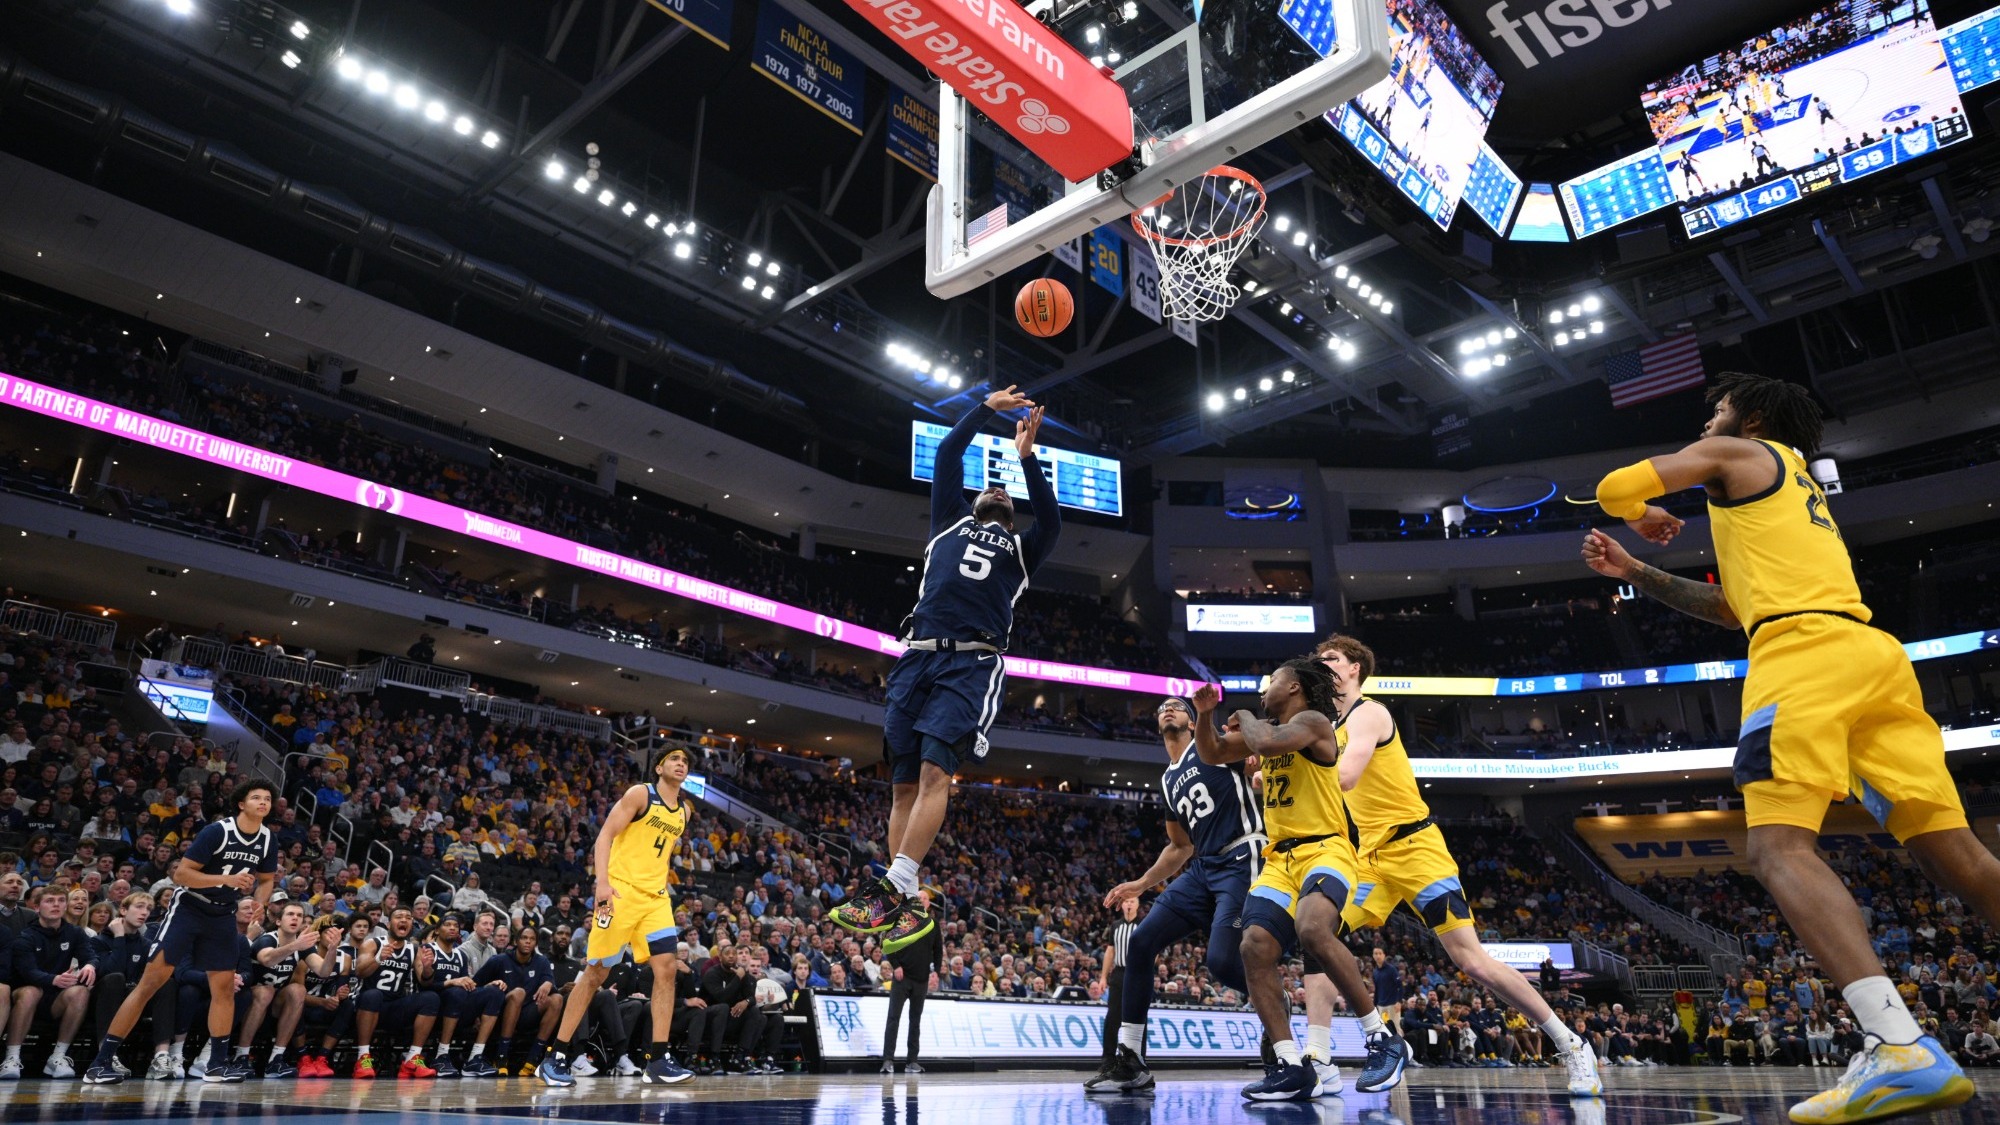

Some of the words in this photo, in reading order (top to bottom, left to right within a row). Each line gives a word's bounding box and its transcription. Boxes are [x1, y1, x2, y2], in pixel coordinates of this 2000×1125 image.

[798, 24, 829, 56] NCAA
[1486, 0, 1672, 69] fise
[780, 28, 812, 62] FINAL
[815, 53, 843, 81] FOUR
[764, 54, 790, 80] 1974
[796, 74, 821, 98] 1977
[825, 94, 853, 120] 2003
[1852, 150, 1885, 171] 39
[1797, 162, 1839, 185] 13:53
[1810, 178, 1831, 191] 2nd
[1758, 186, 1787, 204] 40
[1098, 243, 1119, 276] 20
[1136, 272, 1157, 302] 43
[11, 382, 87, 419] PARTNER
[89, 405, 113, 425] OF
[114, 412, 206, 453] MARQUETTE
[208, 439, 292, 478] UNIVERSITY
[1075, 454, 1100, 467] BUTLER
[958, 527, 1014, 555] BUTLER
[959, 543, 996, 581] 5
[576, 546, 619, 573] TRUSTED
[620, 560, 661, 585] PARTNER
[663, 572, 675, 588] OF
[676, 576, 729, 604] MARQUETTE
[729, 593, 778, 617] UNIVERSITY
[1914, 640, 1946, 656] 40
[1511, 680, 1535, 693] FLS
[1554, 677, 1567, 691] 2
[1599, 672, 1625, 686] TOL
[1644, 669, 1659, 683] 2
[1466, 763, 1479, 773] of
[1481, 763, 1501, 774] the
[1505, 763, 1574, 775] Milwaukee
[1578, 760, 1619, 772] Bucks
[1171, 766, 1201, 799] BUTLER
[1266, 774, 1294, 808] 22
[1177, 782, 1215, 830] 23
[223, 851, 260, 864] BUTLER
[653, 835, 667, 858] 4
[1612, 839, 1735, 859] WE
[380, 960, 408, 970] BUTLER
[1487, 948, 1545, 959] Colder's
[437, 963, 460, 973] BUTLER
[376, 970, 404, 992] 21
[924, 1012, 1000, 1048] THE
